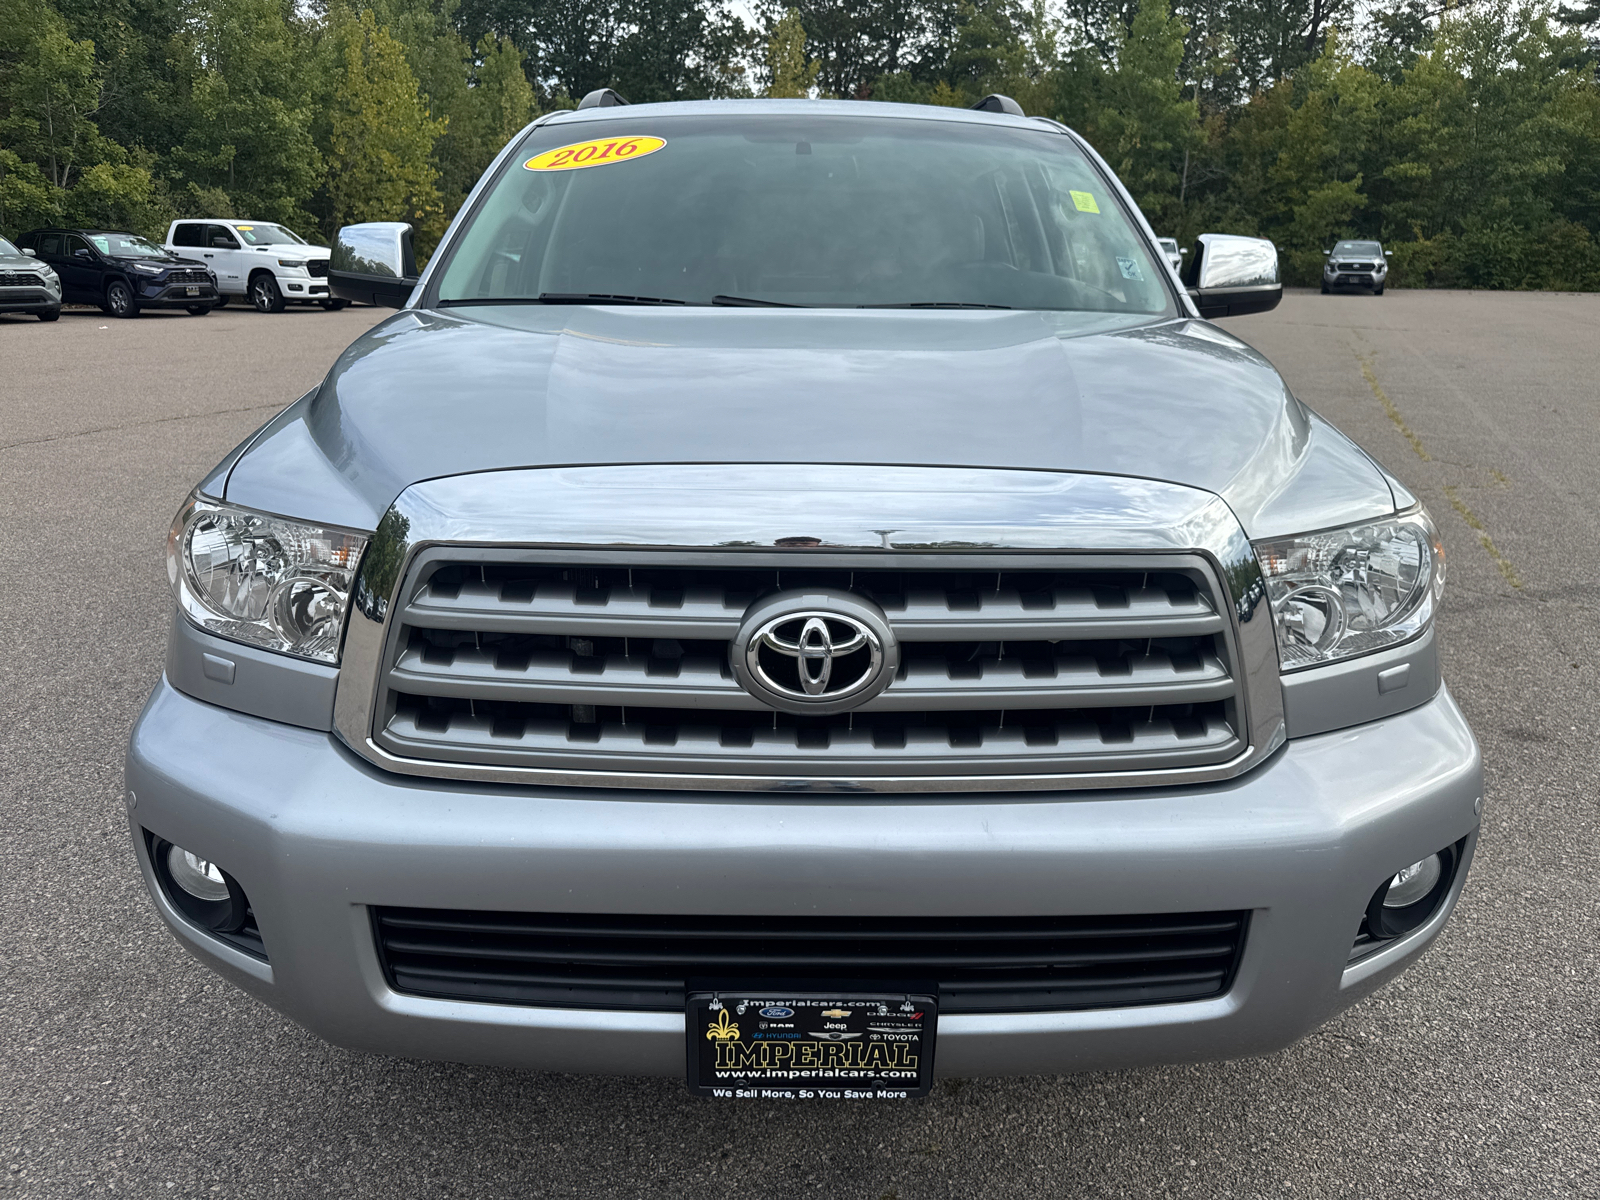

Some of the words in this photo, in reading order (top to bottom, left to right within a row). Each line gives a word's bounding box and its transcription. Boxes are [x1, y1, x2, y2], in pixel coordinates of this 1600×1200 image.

[546, 138, 644, 168] 2016
[823, 1022, 847, 1031] Jeep
[882, 1033, 919, 1041] TOYOTA
[715, 1041, 918, 1069] IMPERIAL
[715, 1069, 917, 1079] www.imperialcars.com
[713, 1089, 732, 1097] We
[735, 1089, 757, 1098] Sell
[761, 1090, 795, 1100] More,
[798, 1090, 814, 1098] So
[818, 1090, 840, 1098] You
[844, 1090, 873, 1098] Save
